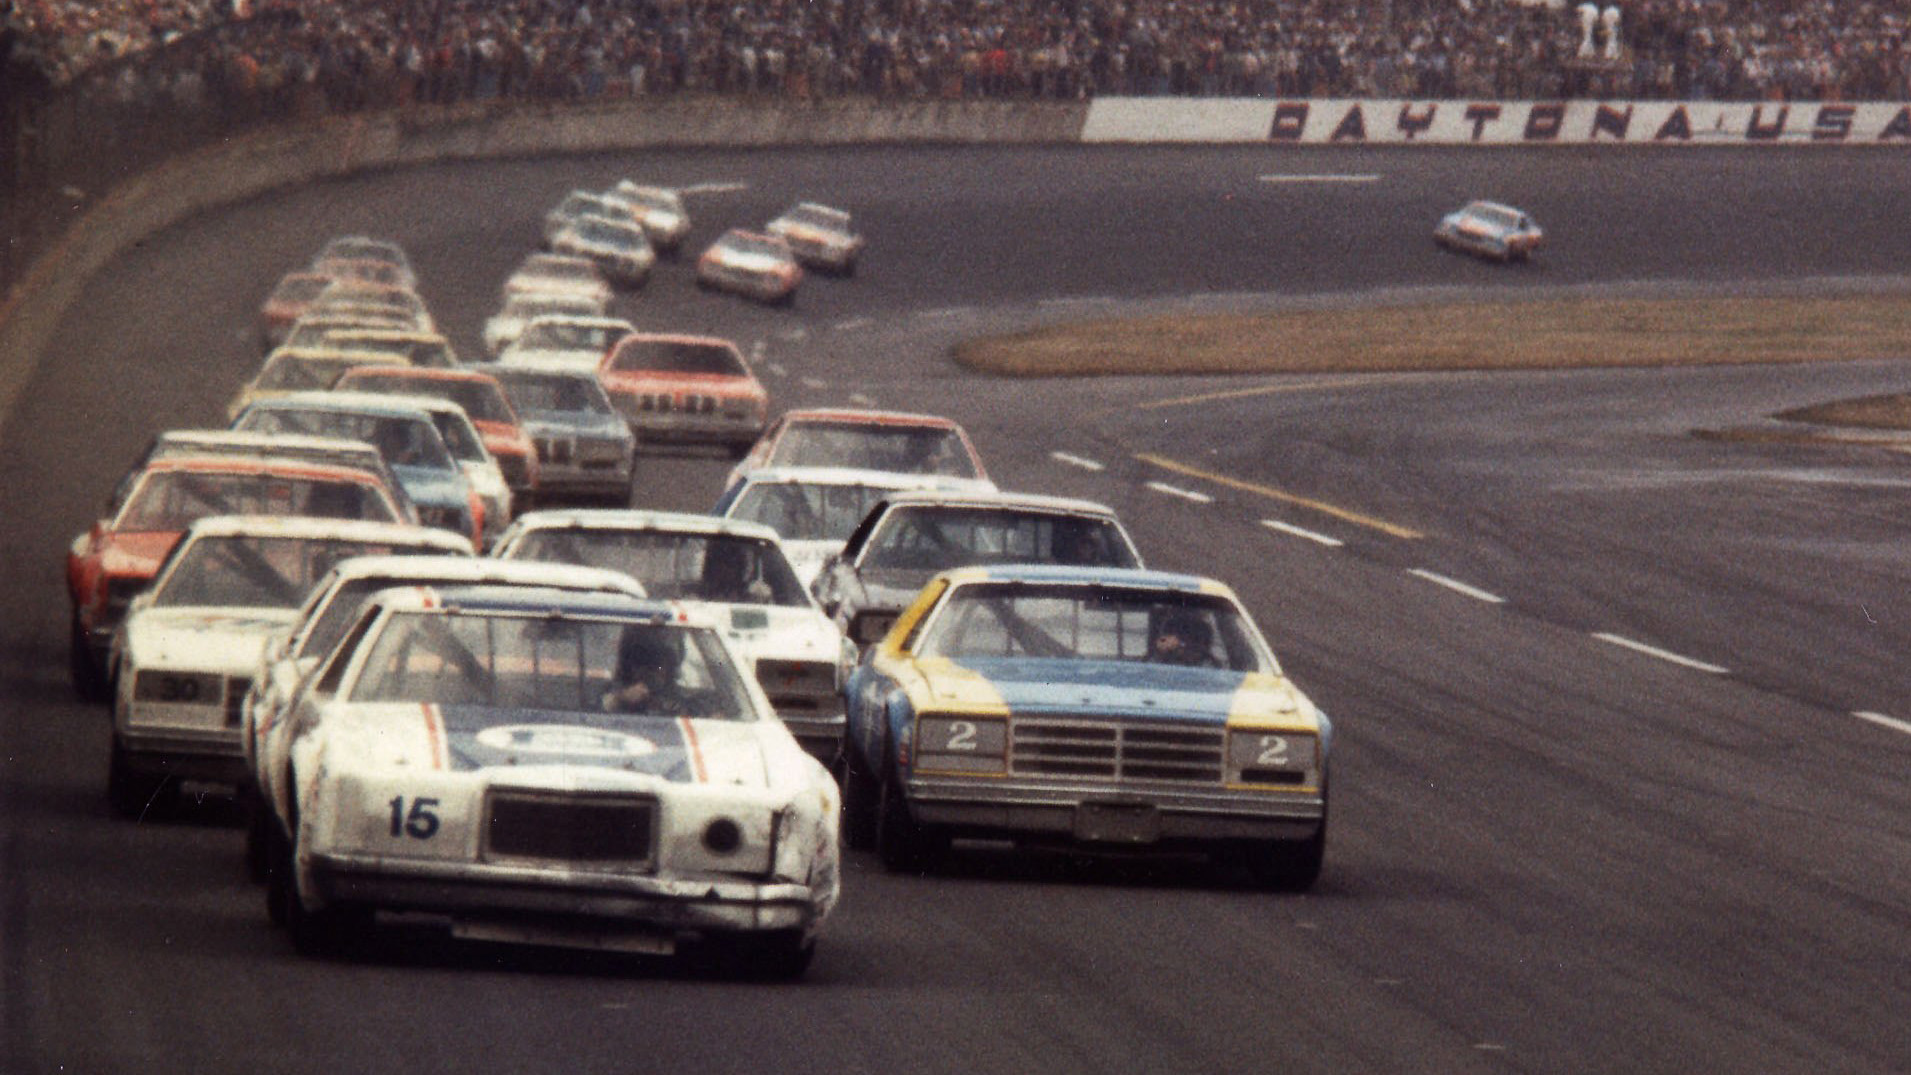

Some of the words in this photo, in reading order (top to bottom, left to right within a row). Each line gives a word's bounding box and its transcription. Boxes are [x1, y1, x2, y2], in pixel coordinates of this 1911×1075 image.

[1269, 103, 1692, 141] DAYTONA
[1746, 104, 1911, 141] USA
[946, 721, 977, 750] 2
[1257, 735, 1288, 765] 2
[389, 795, 440, 840] 15
